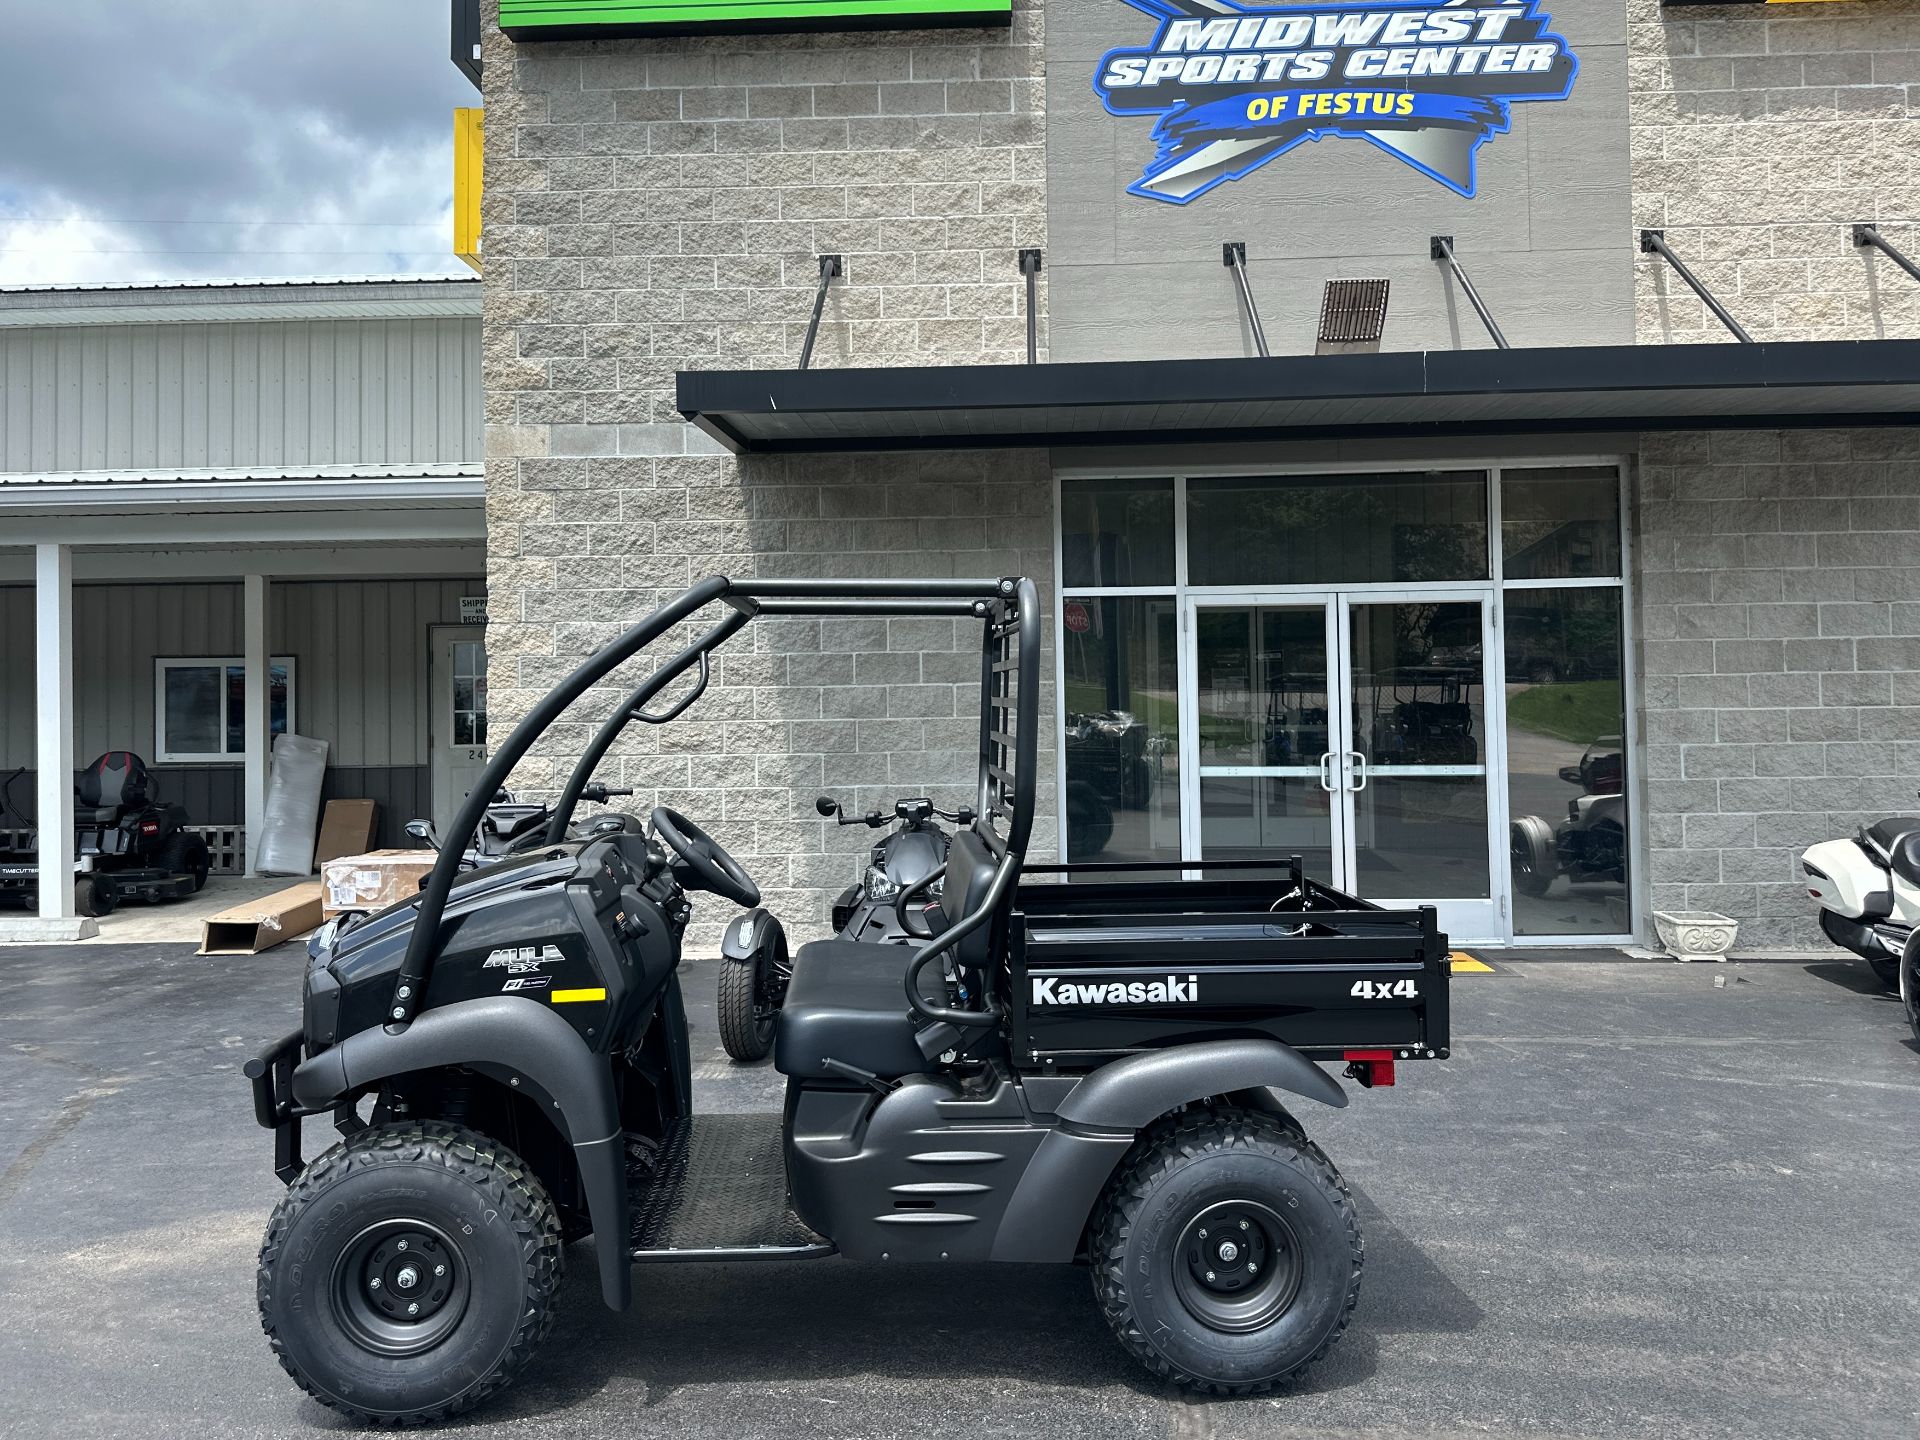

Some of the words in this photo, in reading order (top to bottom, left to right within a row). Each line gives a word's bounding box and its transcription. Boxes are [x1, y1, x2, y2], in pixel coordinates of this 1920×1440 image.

[1167, 8, 1524, 52] MIDWEST
[1104, 51, 1335, 87] SPORTS
[1345, 43, 1557, 77] CENTER
[1247, 96, 1286, 121] OF
[1297, 92, 1414, 117] FESTUS
[482, 945, 565, 968] MULE
[1032, 975, 1198, 1005] Kawasaki
[1350, 979, 1418, 999] 4x4
